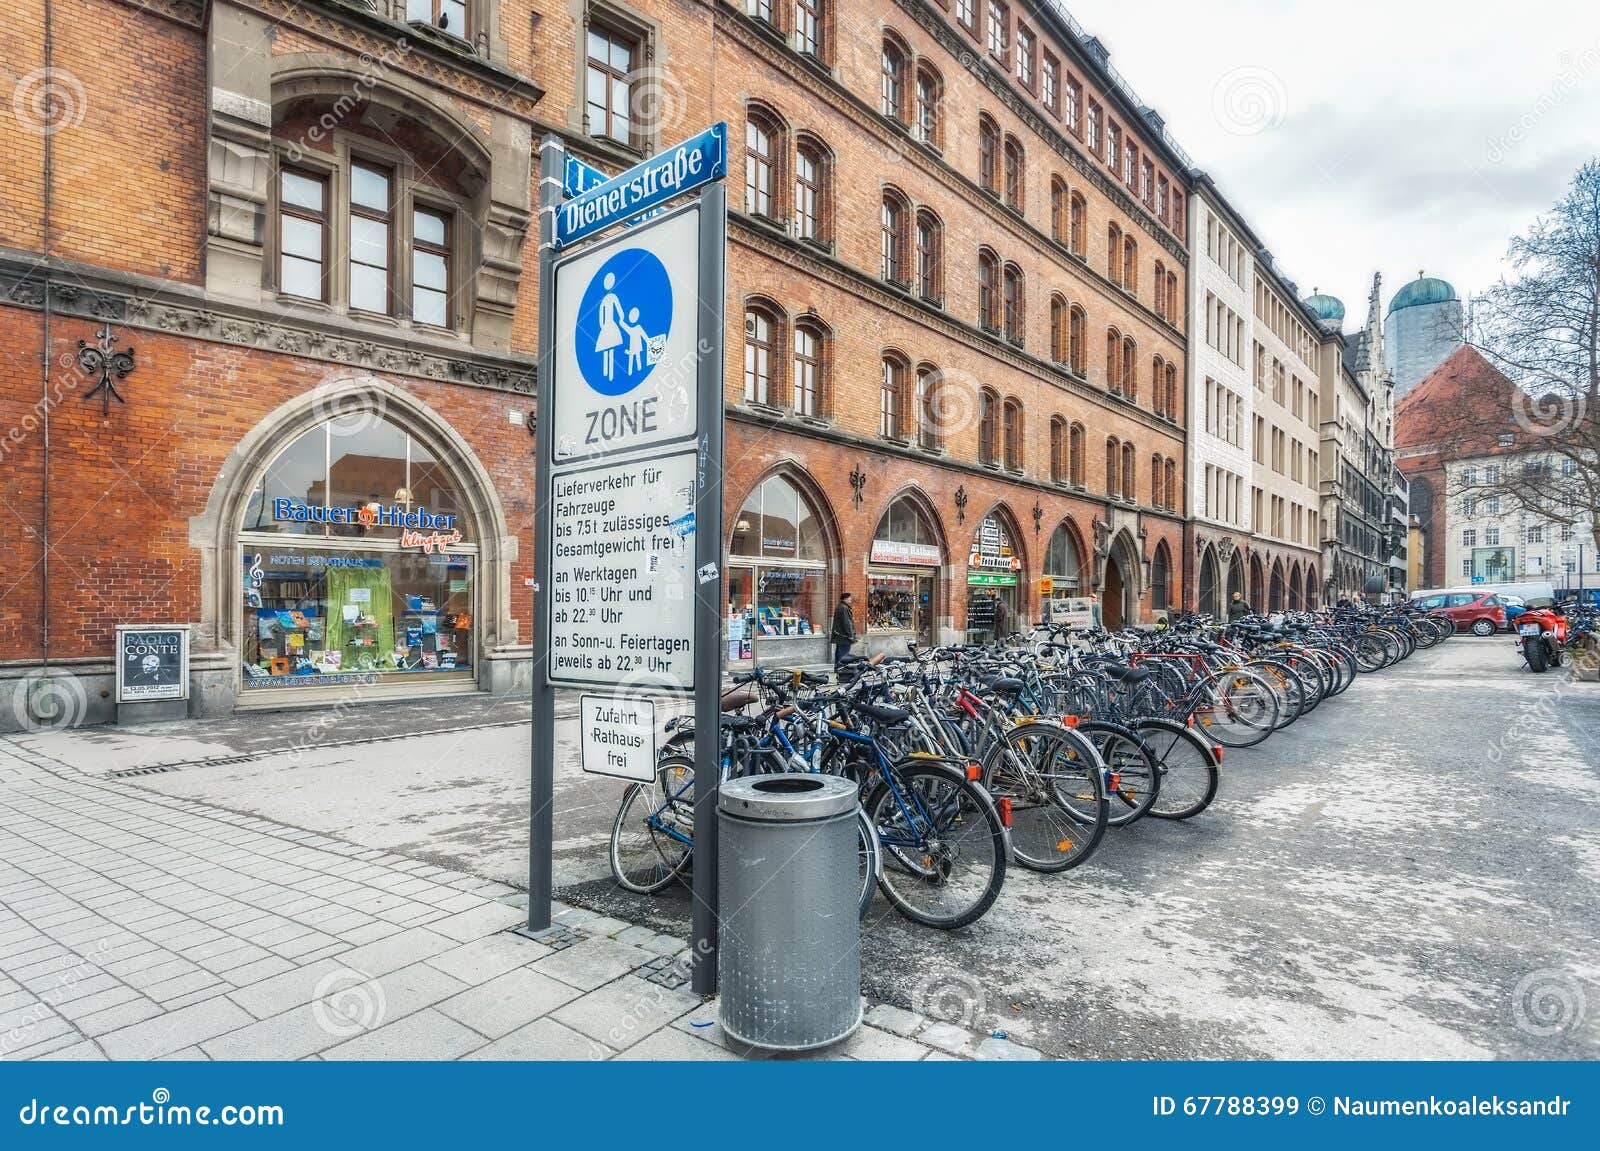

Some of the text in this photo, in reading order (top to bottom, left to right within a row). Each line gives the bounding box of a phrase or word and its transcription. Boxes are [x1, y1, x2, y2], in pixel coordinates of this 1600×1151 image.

[566, 147, 702, 235] Dienerstraße
[585, 397, 657, 444] ZONE
[557, 468, 662, 498] Lieferverkehr für
[275, 498, 456, 530] Bauer Hieber
[556, 499, 615, 518] Fahrzeuge
[556, 522, 571, 537] bis
[603, 513, 670, 534] zulässiges
[402, 528, 462, 554] klingt gut
[556, 534, 674, 558] Gesamtgewicht frei
[556, 567, 637, 584] an Werktagen
[555, 589, 570, 602] bis
[600, 588, 622, 602] Uhr
[628, 586, 652, 601] und
[555, 610, 567, 623] ab
[601, 608, 623, 623] Uhr
[125, 645, 178, 654] CONTE
[555, 636, 567, 647] an
[620, 634, 690, 655] Feiertagen
[554, 653, 593, 670] jeweils
[597, 654, 611, 670] ab
[648, 656, 672, 673] Uhr
[595, 706, 638, 726] Zufahrt
[608, 750, 627, 768] frei
